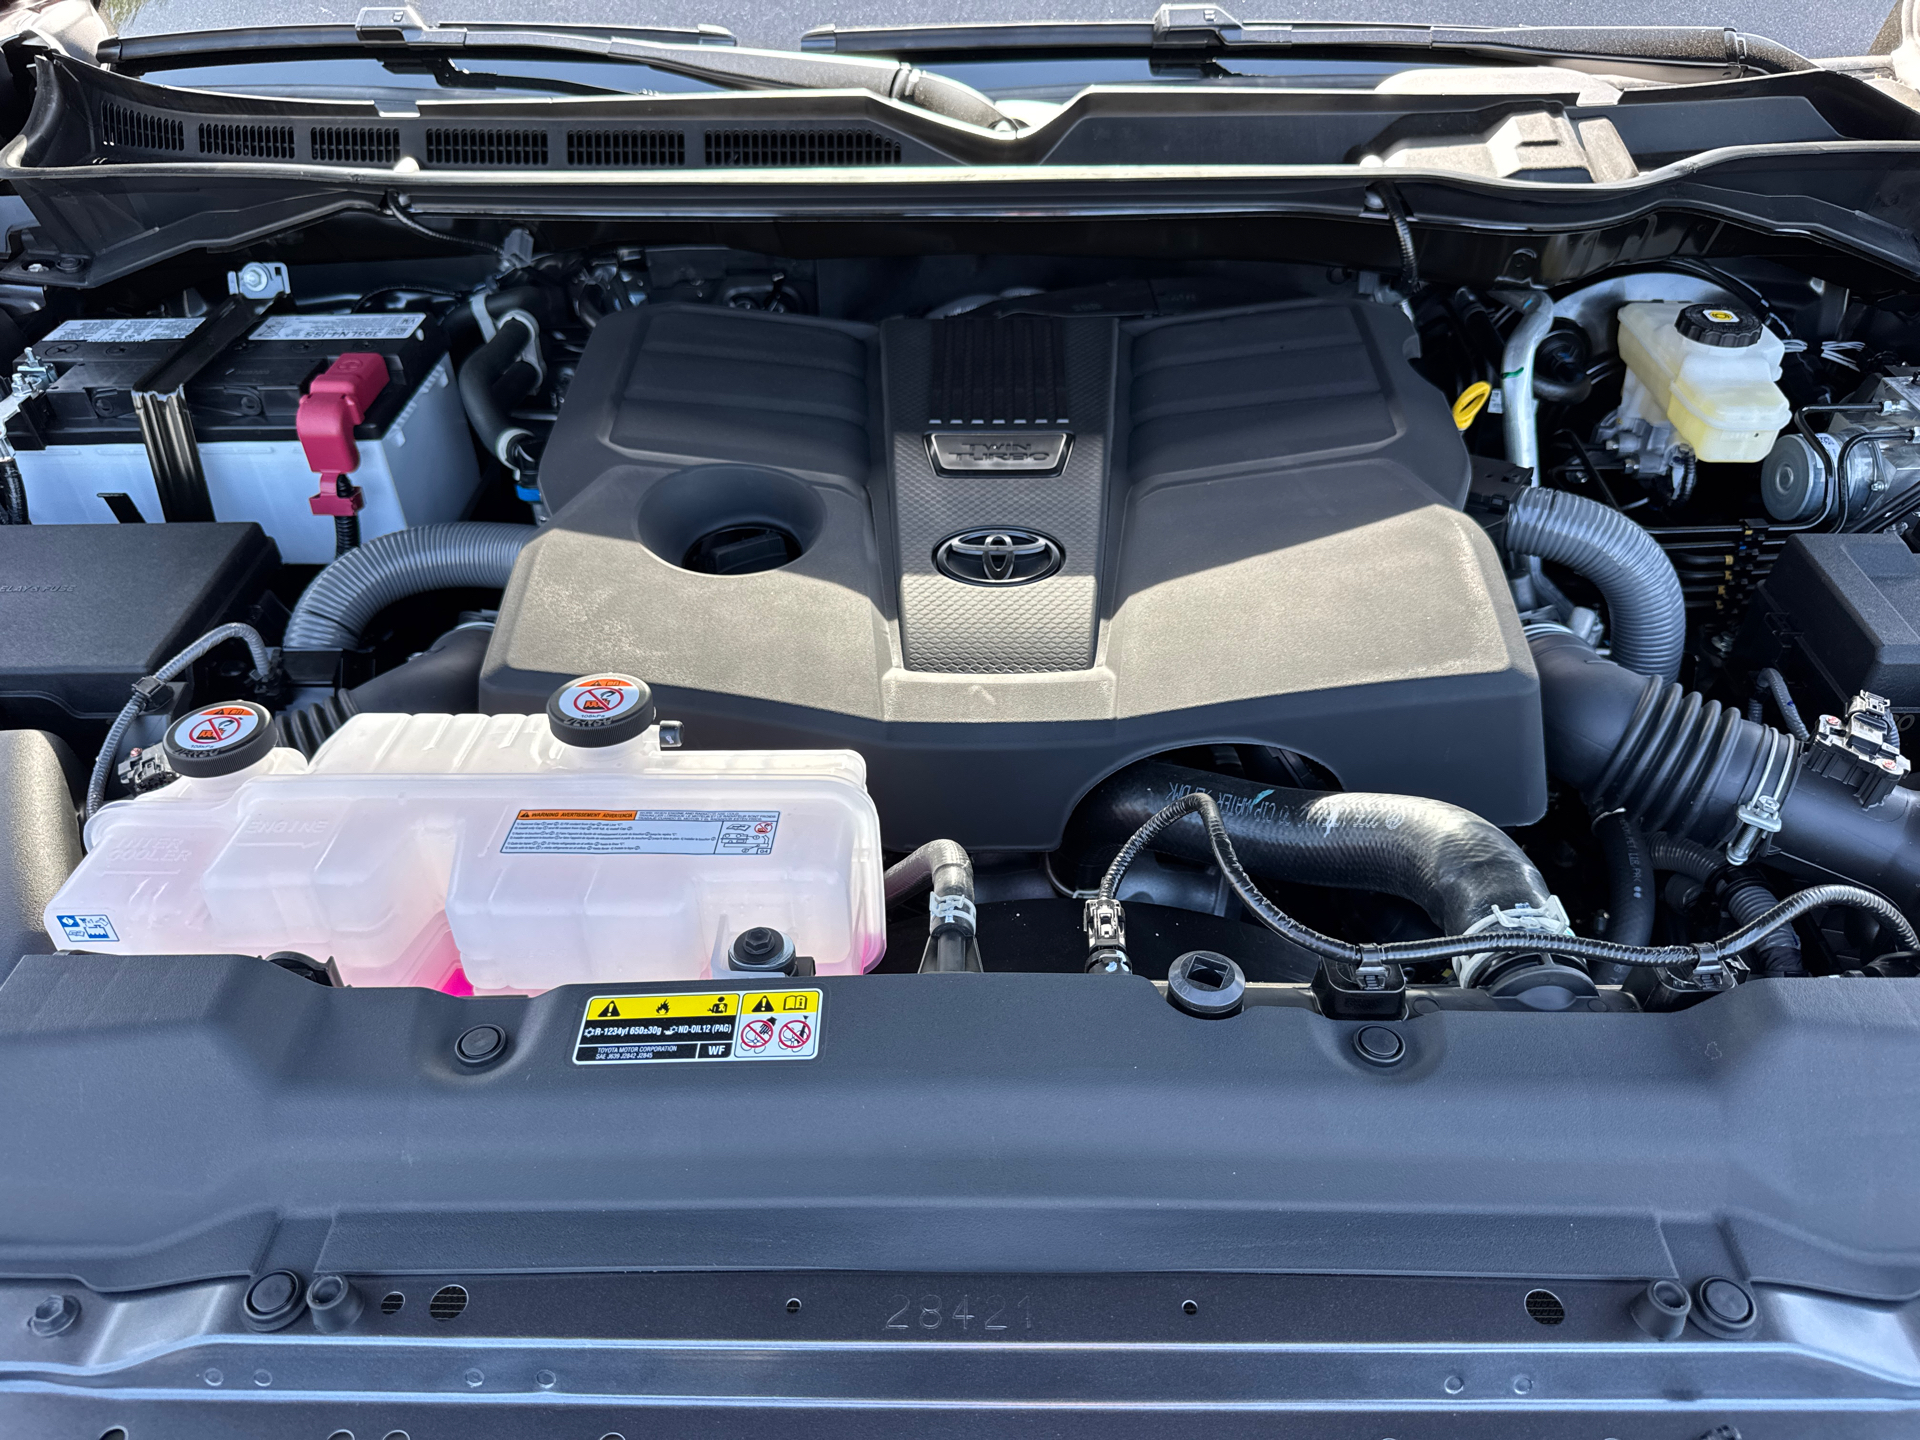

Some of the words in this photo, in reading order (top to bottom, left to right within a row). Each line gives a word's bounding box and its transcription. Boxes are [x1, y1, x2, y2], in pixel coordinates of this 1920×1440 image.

[962, 442, 1032, 450] TWIN
[949, 452, 1049, 461] TURBO
[41, 585, 76, 593] FUSE
[1217, 793, 1252, 817] WATER
[245, 819, 329, 835] ENGINE
[116, 836, 185, 850] INTER
[107, 848, 192, 862] COOLER
[594, 1026, 629, 1037] R-1234yf
[629, 1025, 662, 1036] 650±30g
[712, 1023, 732, 1034] (PAG)
[618, 1045, 638, 1053] MOTOR
[639, 1044, 678, 1052] CORPORATION
[708, 1045, 726, 1056] WF
[607, 1052, 620, 1060] J639
[637, 1051, 653, 1059] J2845
[884, 1293, 1034, 1330] 28421
